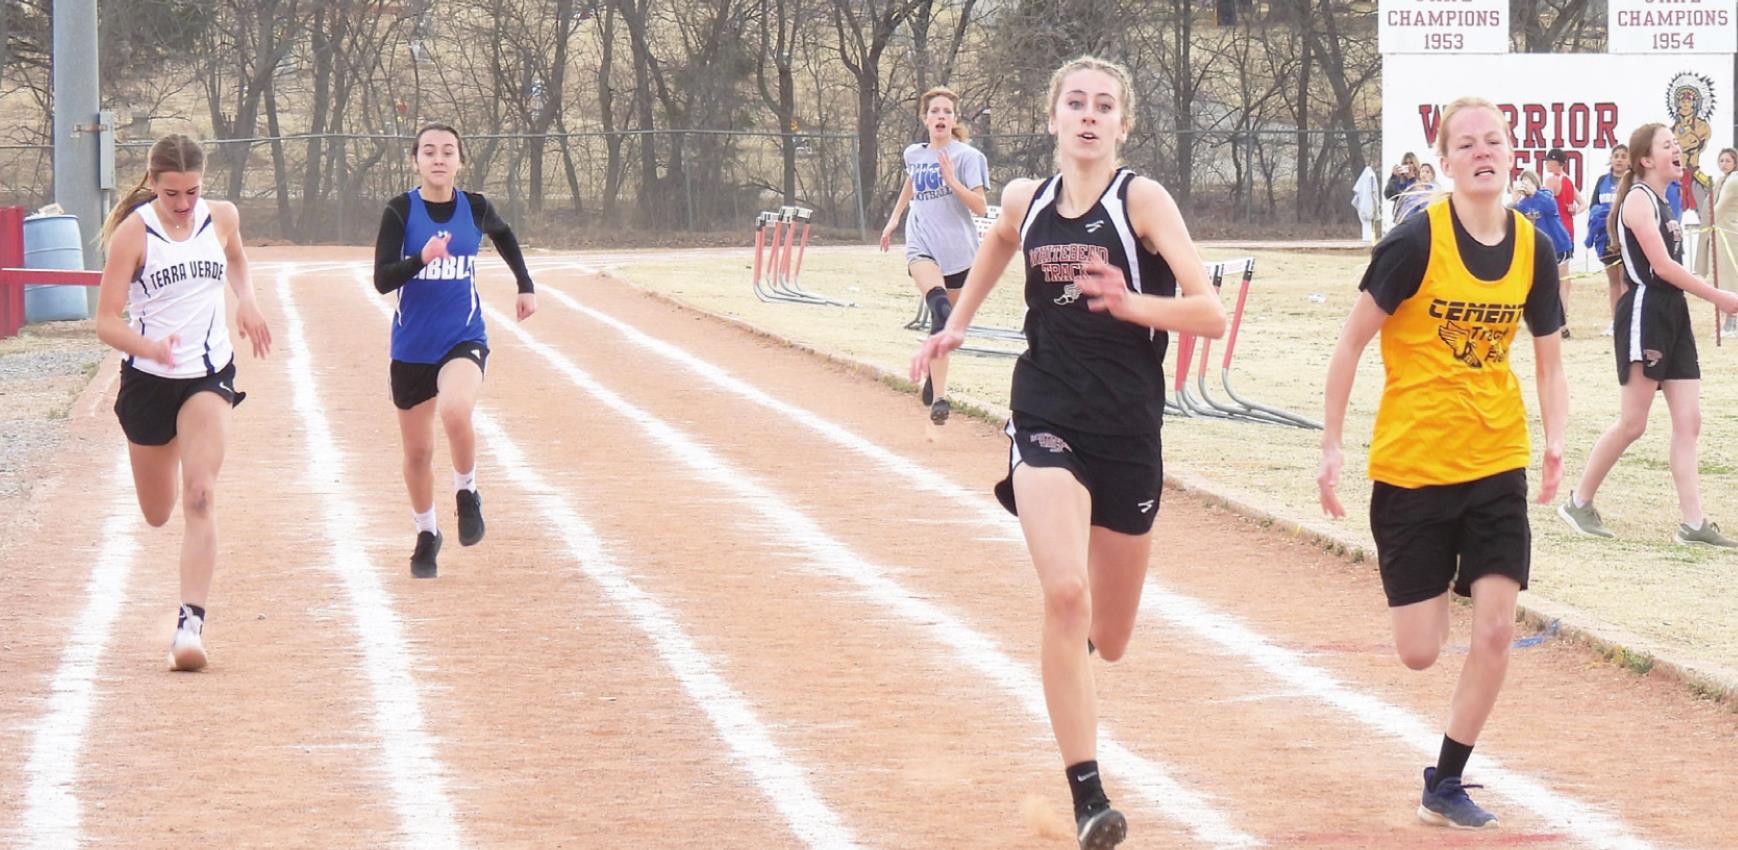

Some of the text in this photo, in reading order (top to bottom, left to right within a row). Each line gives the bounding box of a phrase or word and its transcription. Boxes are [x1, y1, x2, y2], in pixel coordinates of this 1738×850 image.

[1387, 10, 1500, 27] CHAMPIONS
[1617, 10, 1729, 26] CHAMPIONS
[1424, 33, 1464, 50] 1953
[1652, 33, 1695, 50] 1954
[1418, 102, 1619, 149] WRRIOR
[150, 260, 224, 290] TERRA VERDE
